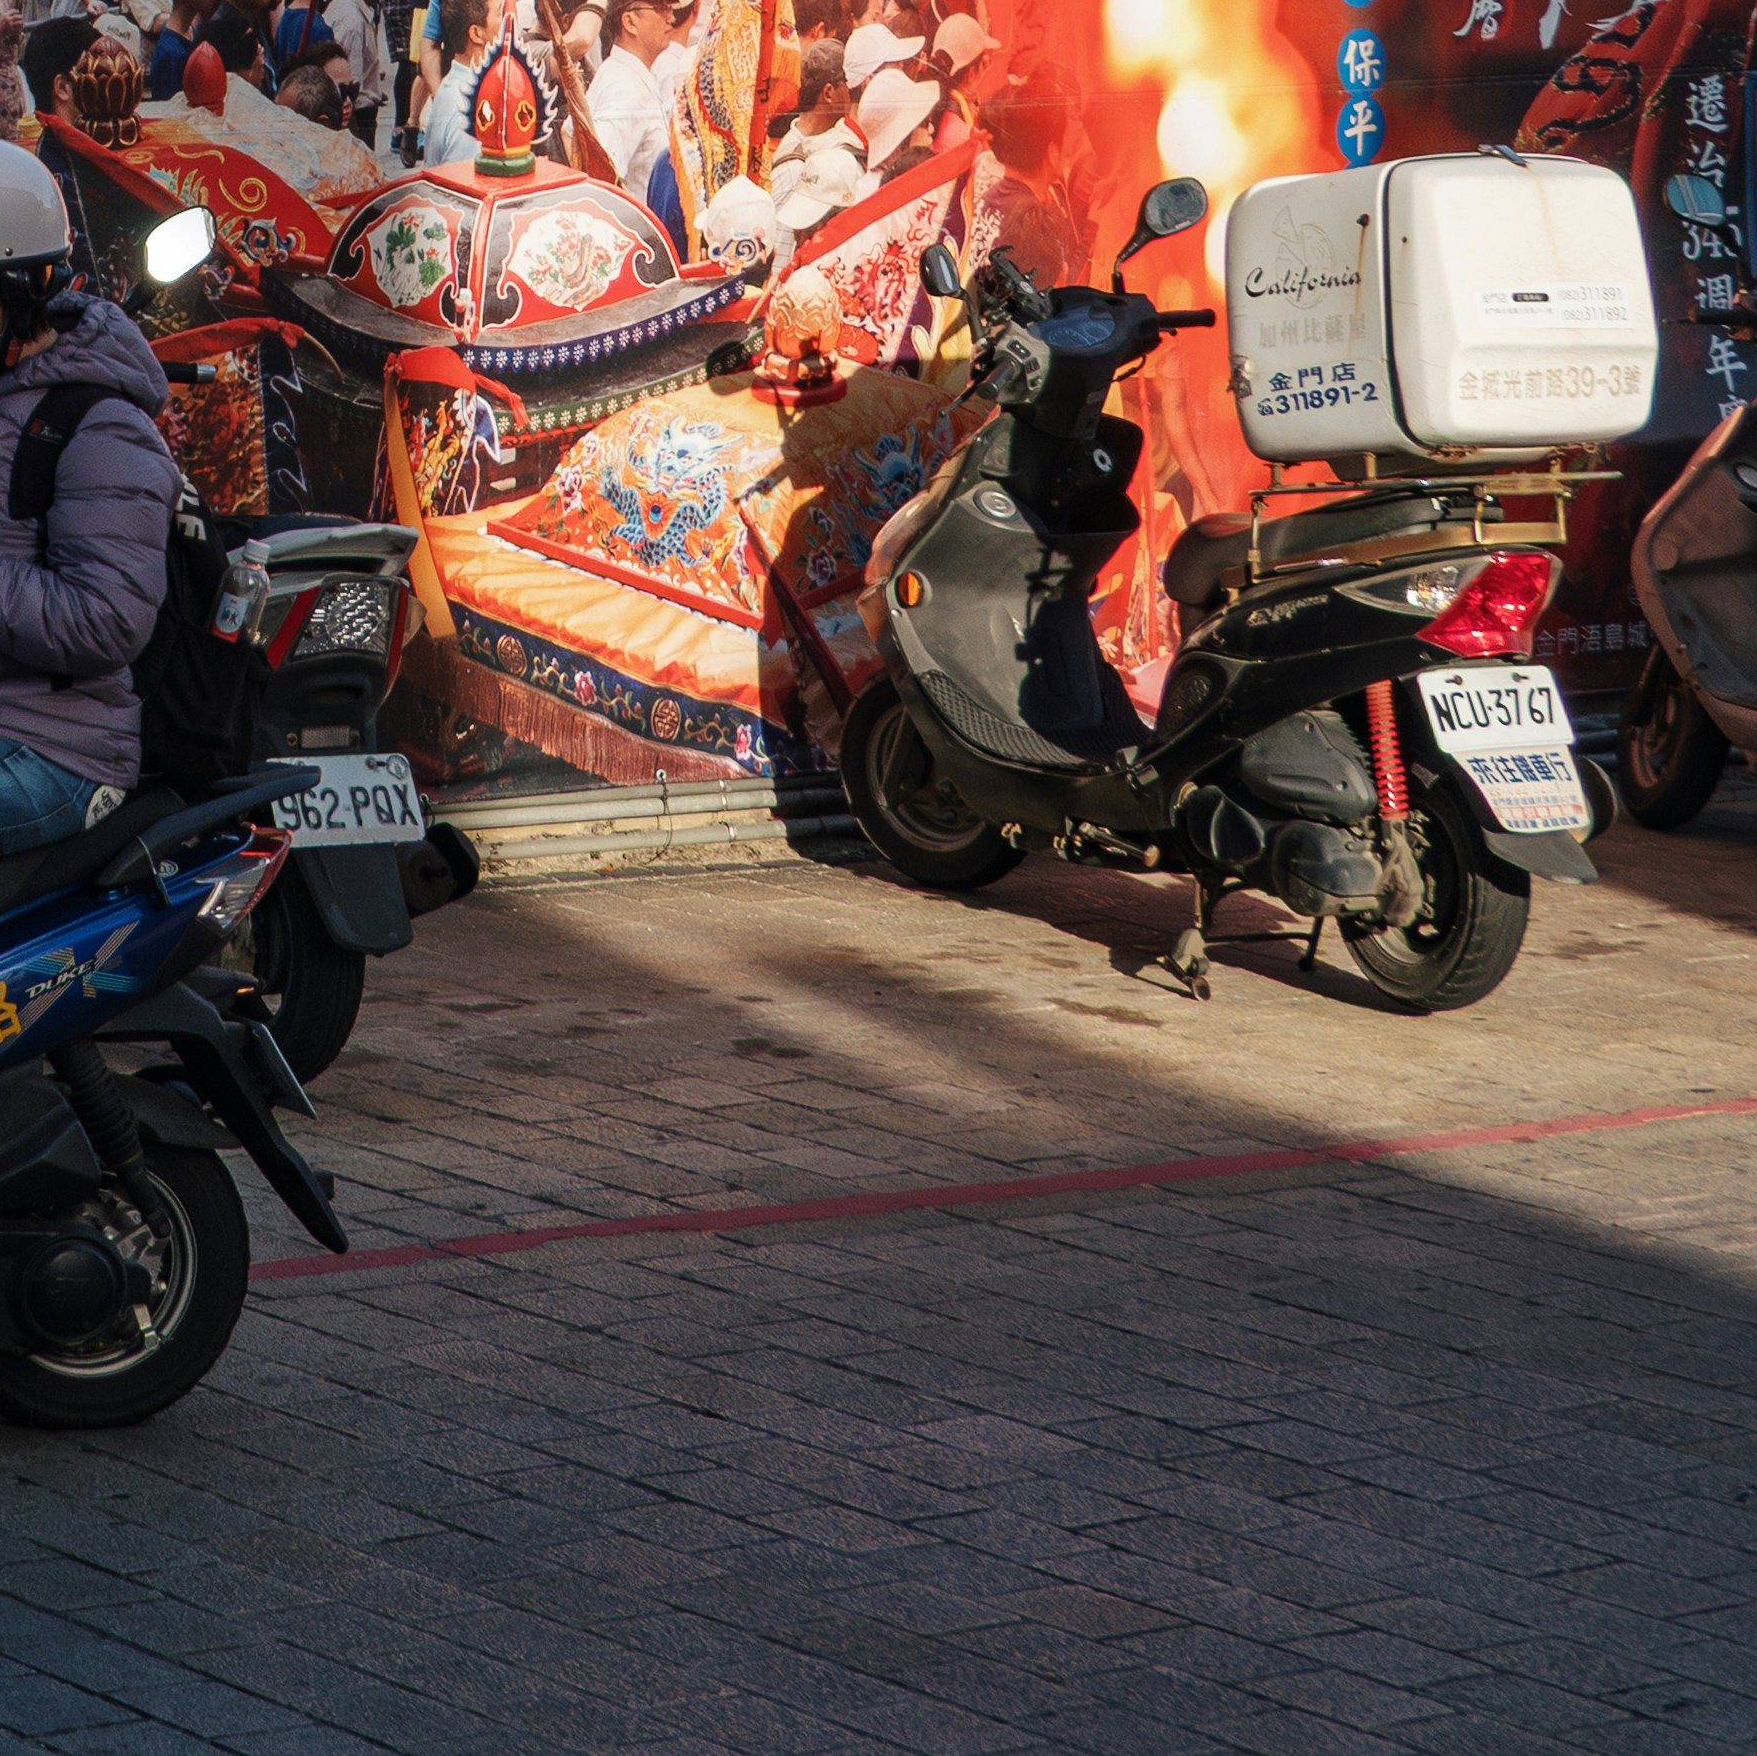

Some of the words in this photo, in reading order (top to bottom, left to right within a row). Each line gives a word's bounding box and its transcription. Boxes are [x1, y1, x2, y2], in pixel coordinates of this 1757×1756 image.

[1342, 39, 1382, 165] 保平
[1244, 265, 1363, 303] California
[1258, 312, 1367, 349] 加州比薩屋
[1268, 362, 1357, 393] 金門店
[1274, 381, 1379, 415] 311891-2
[1534, 620, 1656, 657] 金門浯島城
[1429, 686, 1555, 733] NCU-3767
[276, 783, 420, 831] 962-PQX
[25, 956, 97, 999] DUKE
